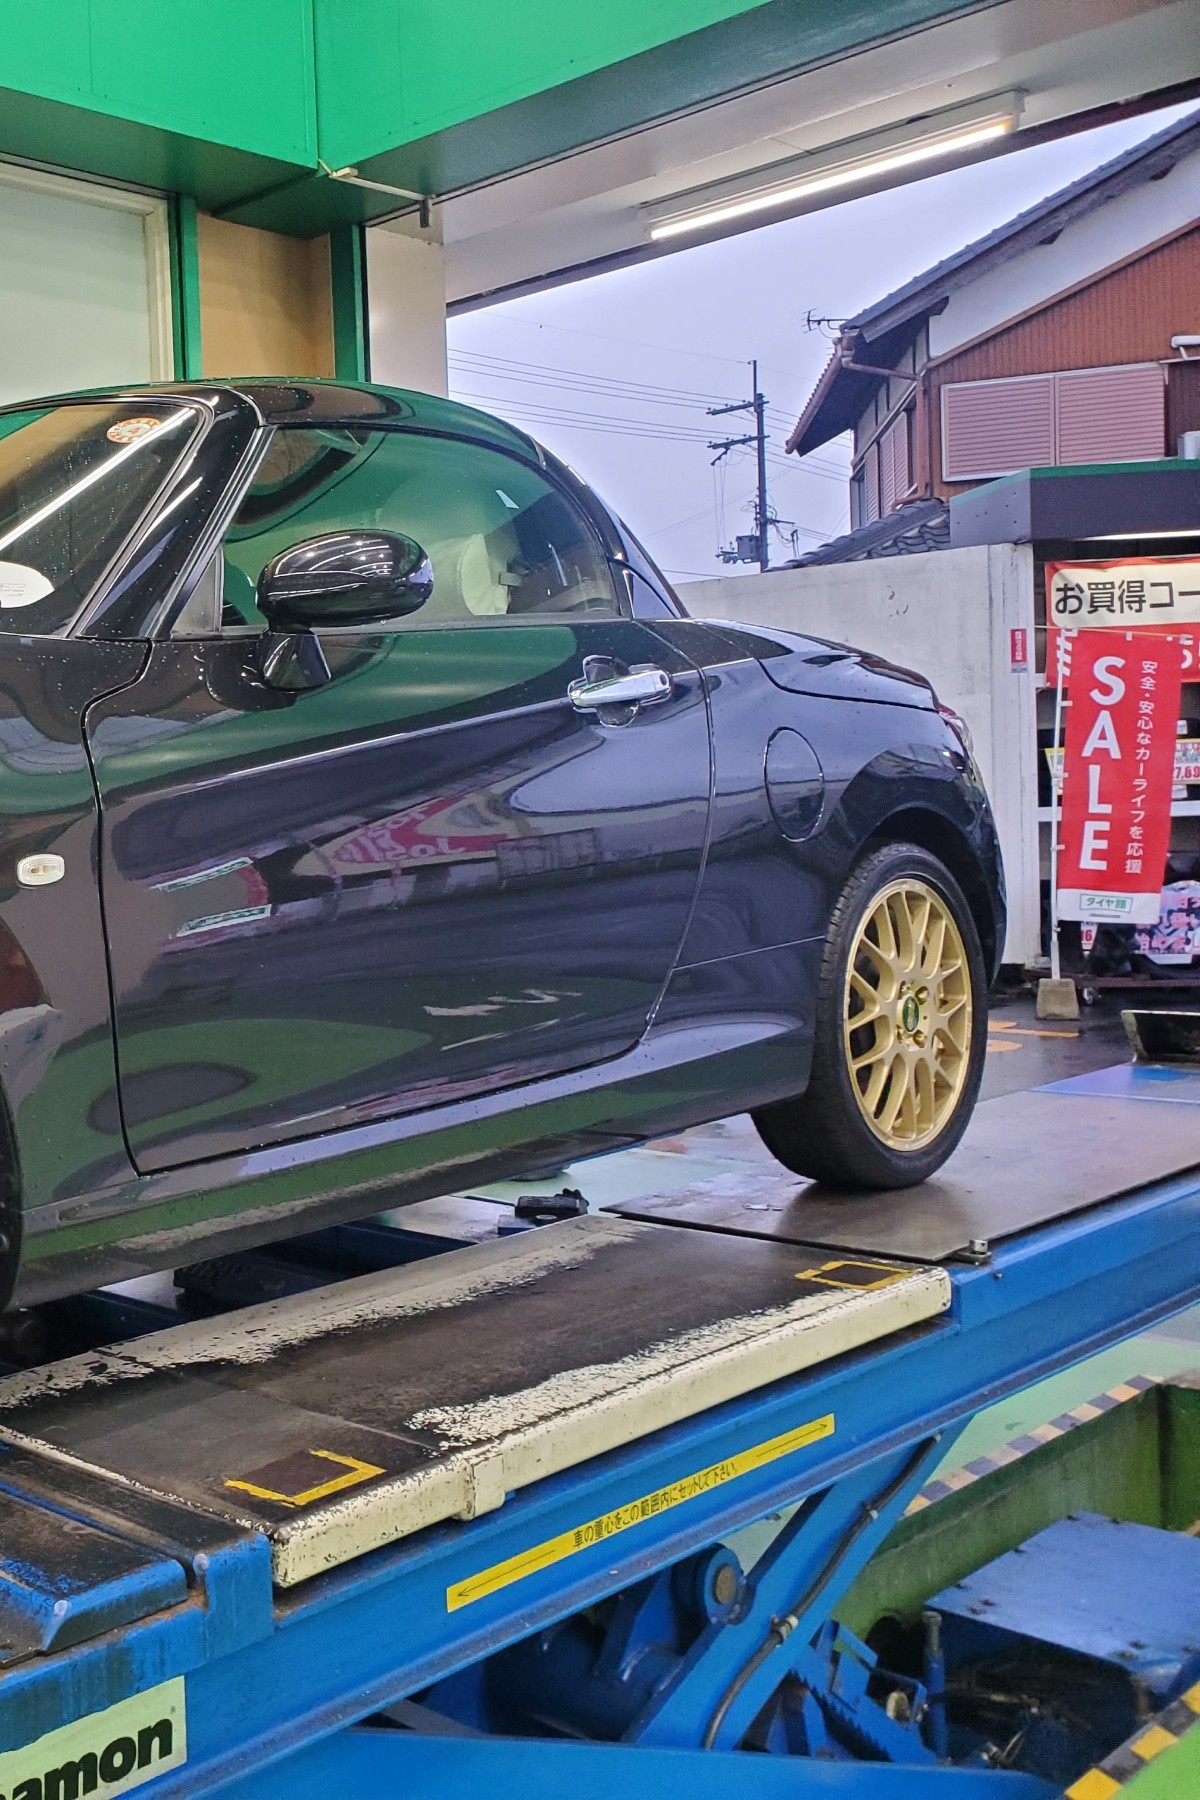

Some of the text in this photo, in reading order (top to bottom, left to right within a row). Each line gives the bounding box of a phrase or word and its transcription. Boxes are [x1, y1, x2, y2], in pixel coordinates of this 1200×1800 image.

[1078, 655, 1127, 872] SALE
[1124, 660, 1159, 875] 安全・安心なカーライフを応援
